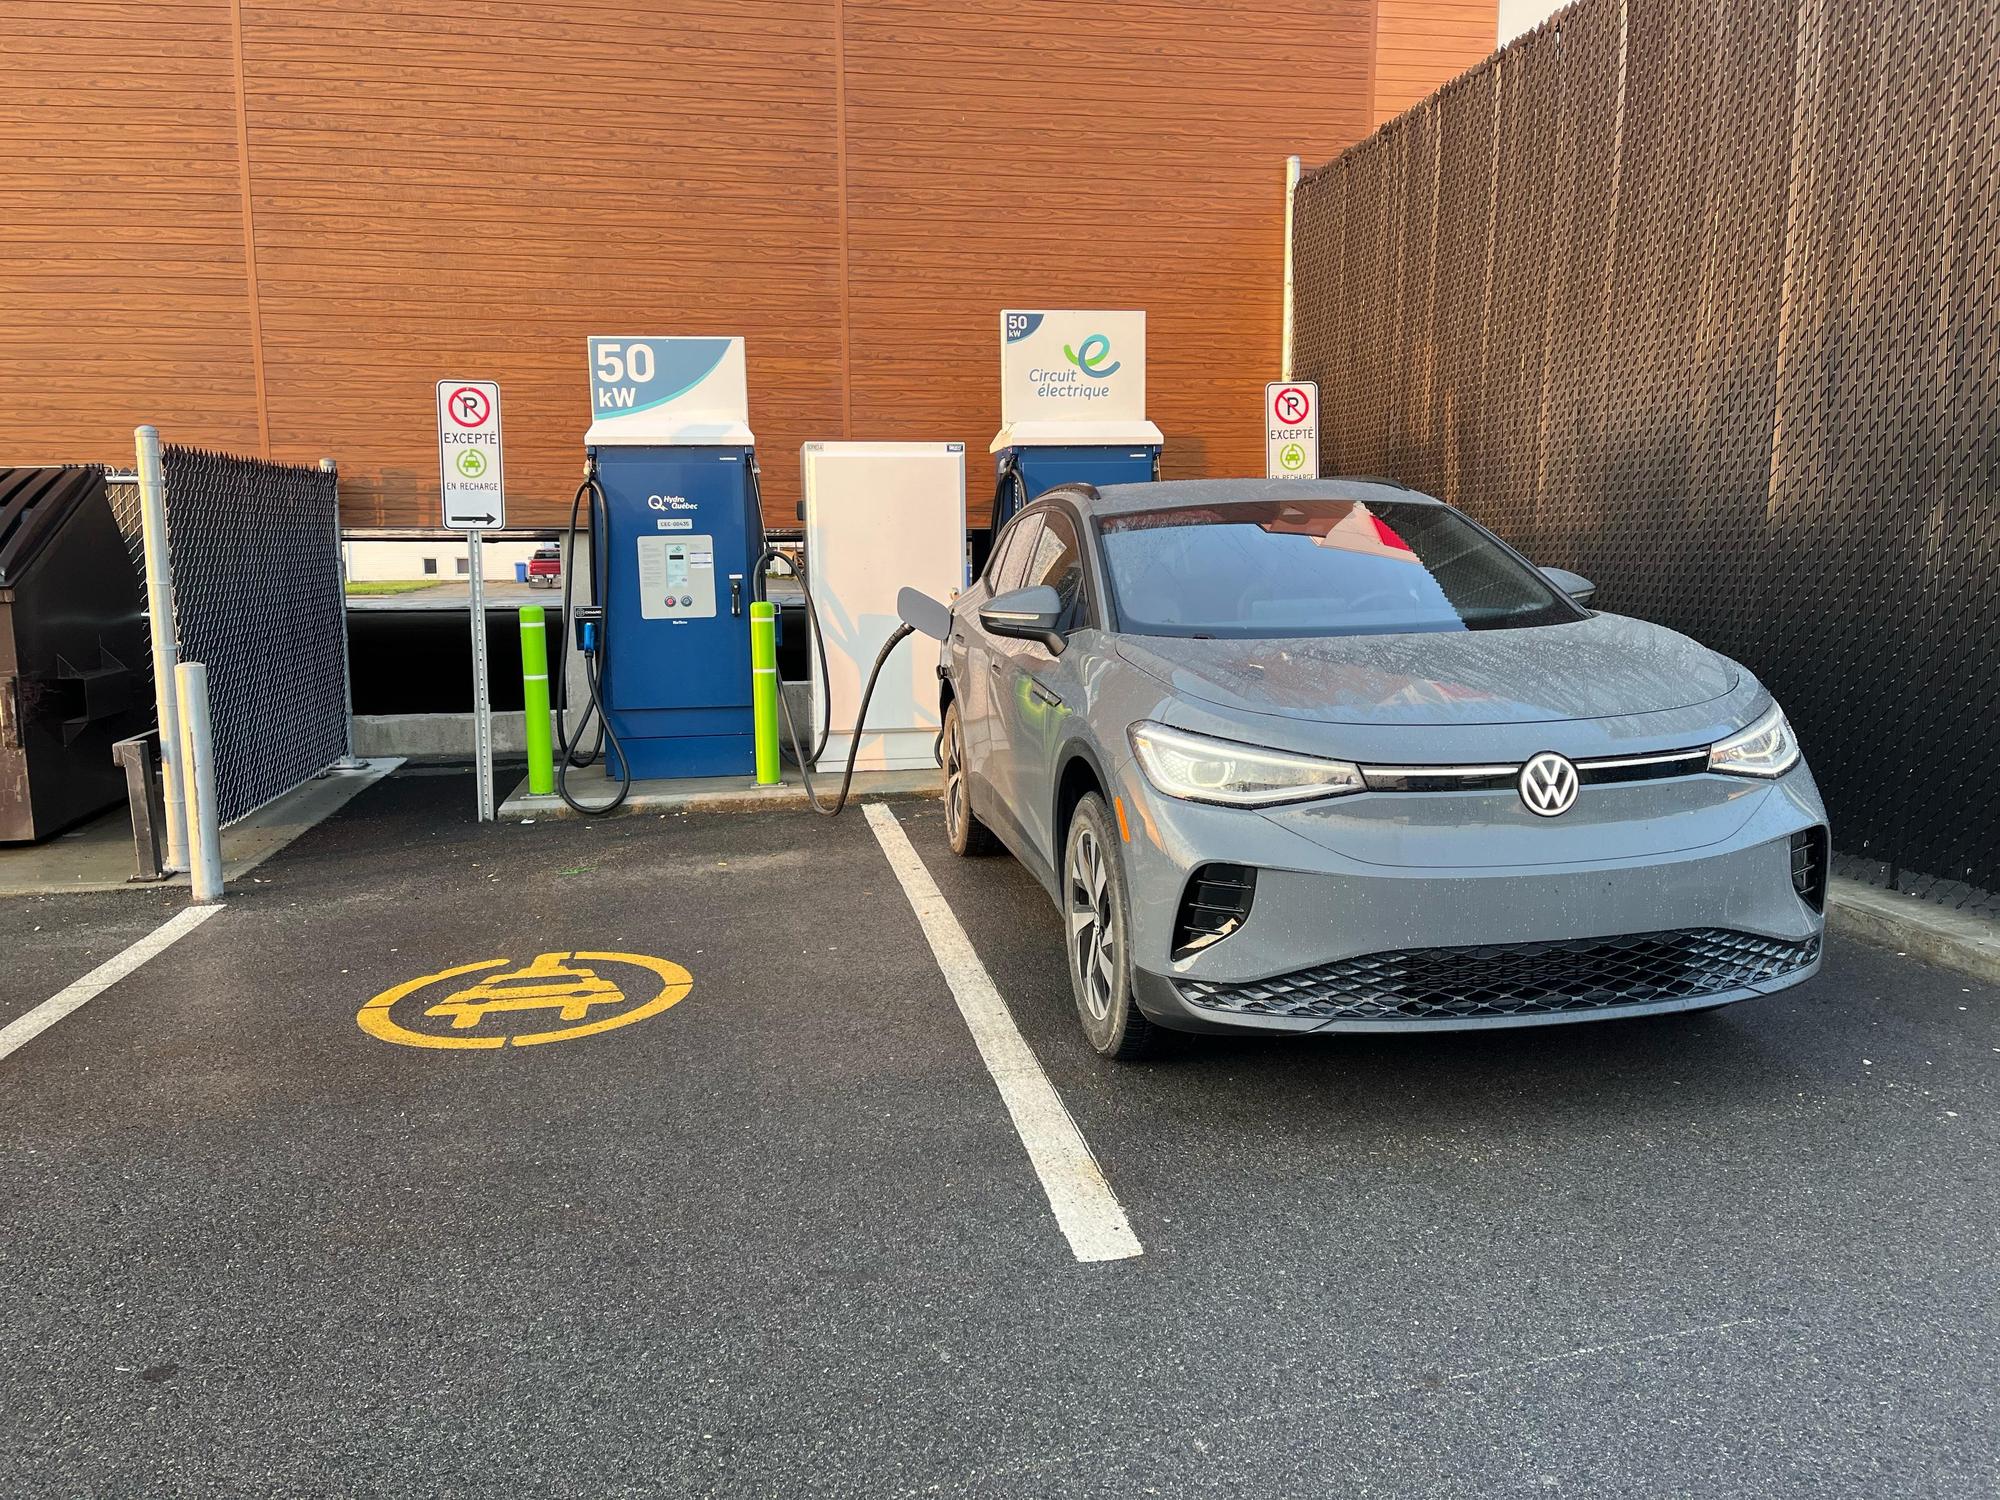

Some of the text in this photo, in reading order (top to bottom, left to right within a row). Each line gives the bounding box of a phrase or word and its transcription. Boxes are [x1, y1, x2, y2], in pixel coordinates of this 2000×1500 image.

[1008, 315, 1028, 330] 50
[1008, 329, 1021, 338] kW
[597, 343, 655, 383] 50
[1029, 368, 1077, 382] Circuit
[598, 387, 636, 408] kW
[1038, 383, 1110, 400] électrique
[444, 431, 497, 445] EXCEPTÉ
[1270, 426, 1314, 440] EXCEPTÉ
[446, 482, 499, 491] EN RECHARGE
[663, 495, 685, 503] Hydro
[671, 502, 698, 510] Québec
